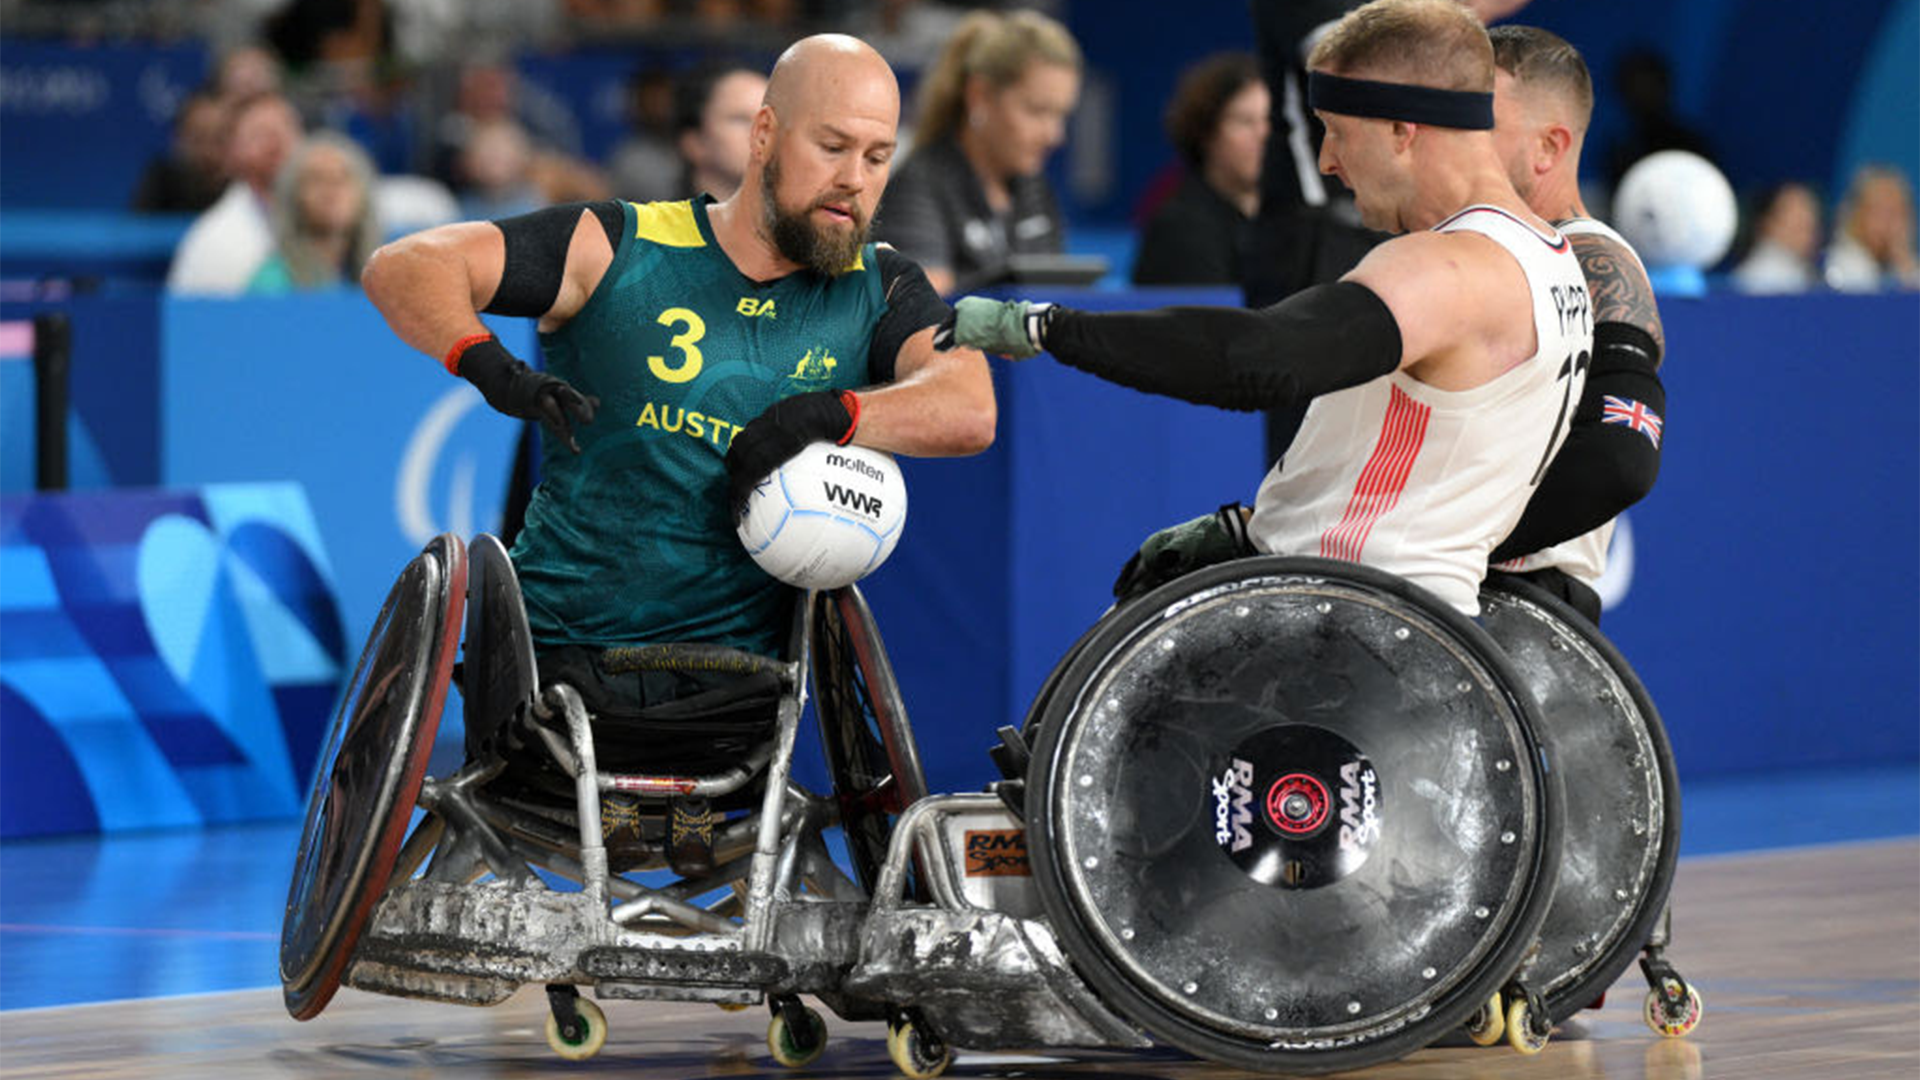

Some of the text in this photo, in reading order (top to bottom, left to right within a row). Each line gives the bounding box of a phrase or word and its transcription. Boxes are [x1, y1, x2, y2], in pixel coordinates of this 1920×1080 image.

[647, 307, 706, 384] 3
[826, 453, 884, 483] molten
[968, 834, 1027, 850] RM
[1212, 757, 1254, 853] RMA Sport
[1339, 761, 1380, 853] RMA Sport
